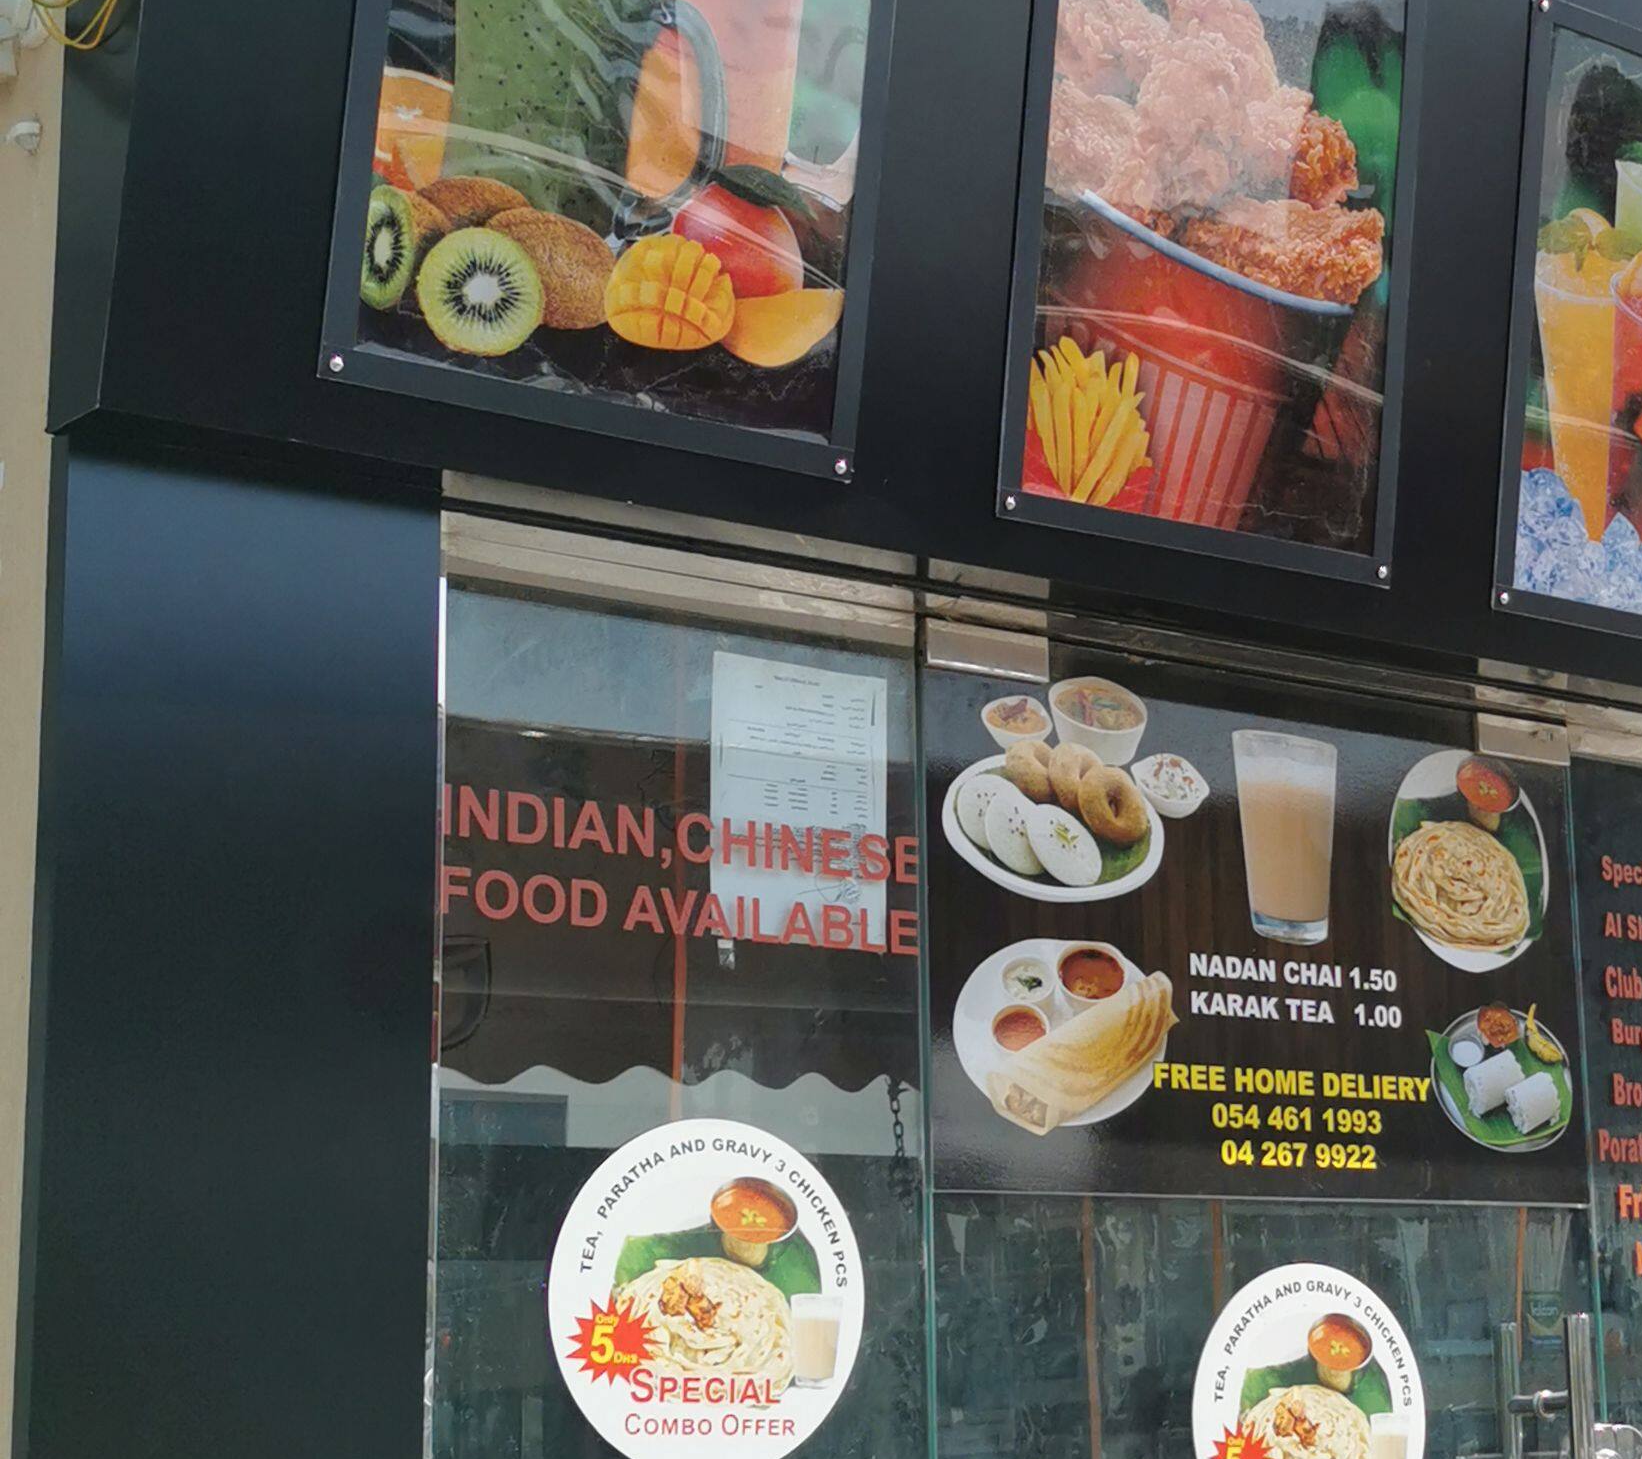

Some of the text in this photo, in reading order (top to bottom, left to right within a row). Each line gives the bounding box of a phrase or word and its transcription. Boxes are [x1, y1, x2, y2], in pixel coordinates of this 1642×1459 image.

[440, 866, 919, 956] FOOD AVAILABLE
[1604, 912, 1622, 938] Al
[1189, 952, 1398, 993] NADAN CHAI 1.50
[1190, 990, 1402, 1029] KARAK TEA 1.00
[1153, 1061, 1432, 1103] FREE HOME DELIERY
[1212, 1103, 1383, 1136] 054 461 1993
[1221, 1139, 1378, 1171] 04 267 9922
[580, 1138, 848, 1288] TEA, PARATHA AND GRAVY 3 CHICKEN PCS
[590, 1324, 615, 1364] 5
[1214, 1279, 1412, 1407] TEA, PARATHA AND GRAVY 3 CHICKEN PCS
